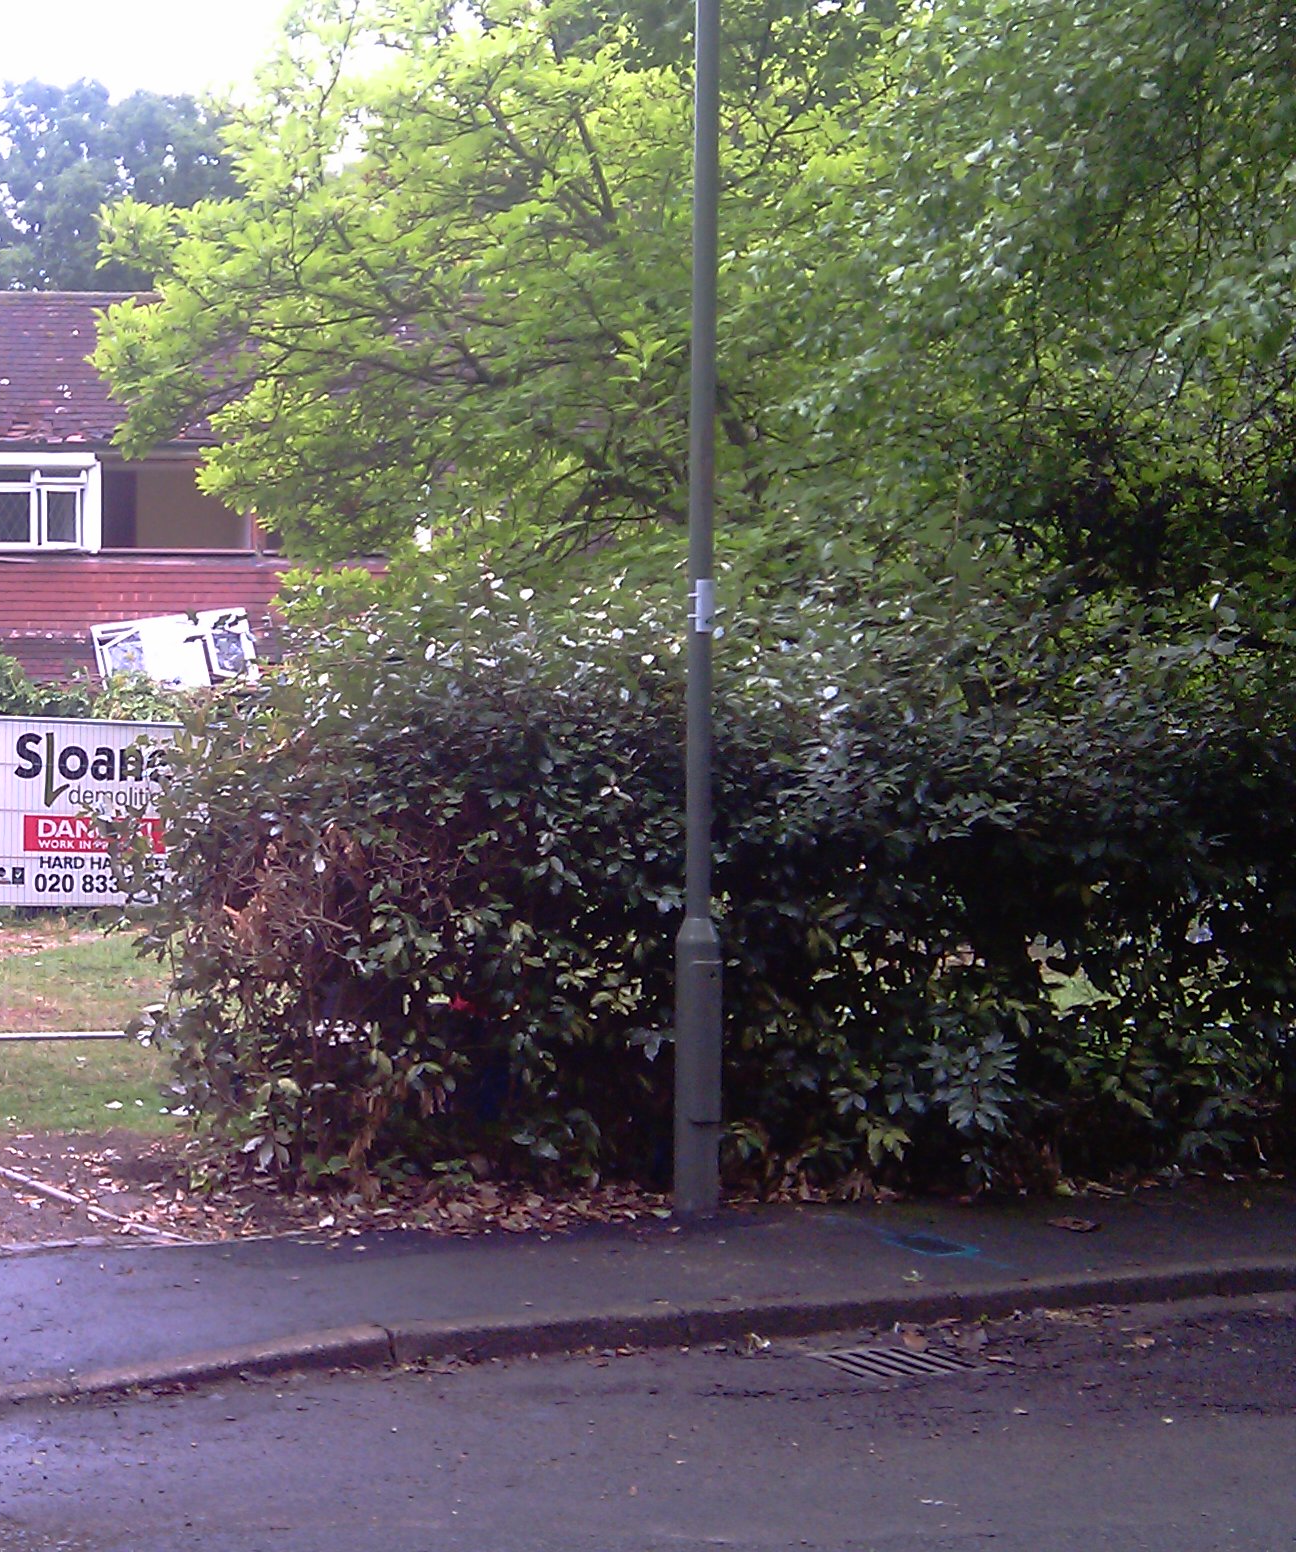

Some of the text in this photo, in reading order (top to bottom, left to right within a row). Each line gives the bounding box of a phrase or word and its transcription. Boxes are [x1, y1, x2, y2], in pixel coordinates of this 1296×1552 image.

[68, 785, 160, 806] demoliti
[38, 839, 74, 849] WORK
[79, 840, 92, 850] IN
[39, 856, 112, 870] HARD HA
[34, 874, 120, 894] 020 833
